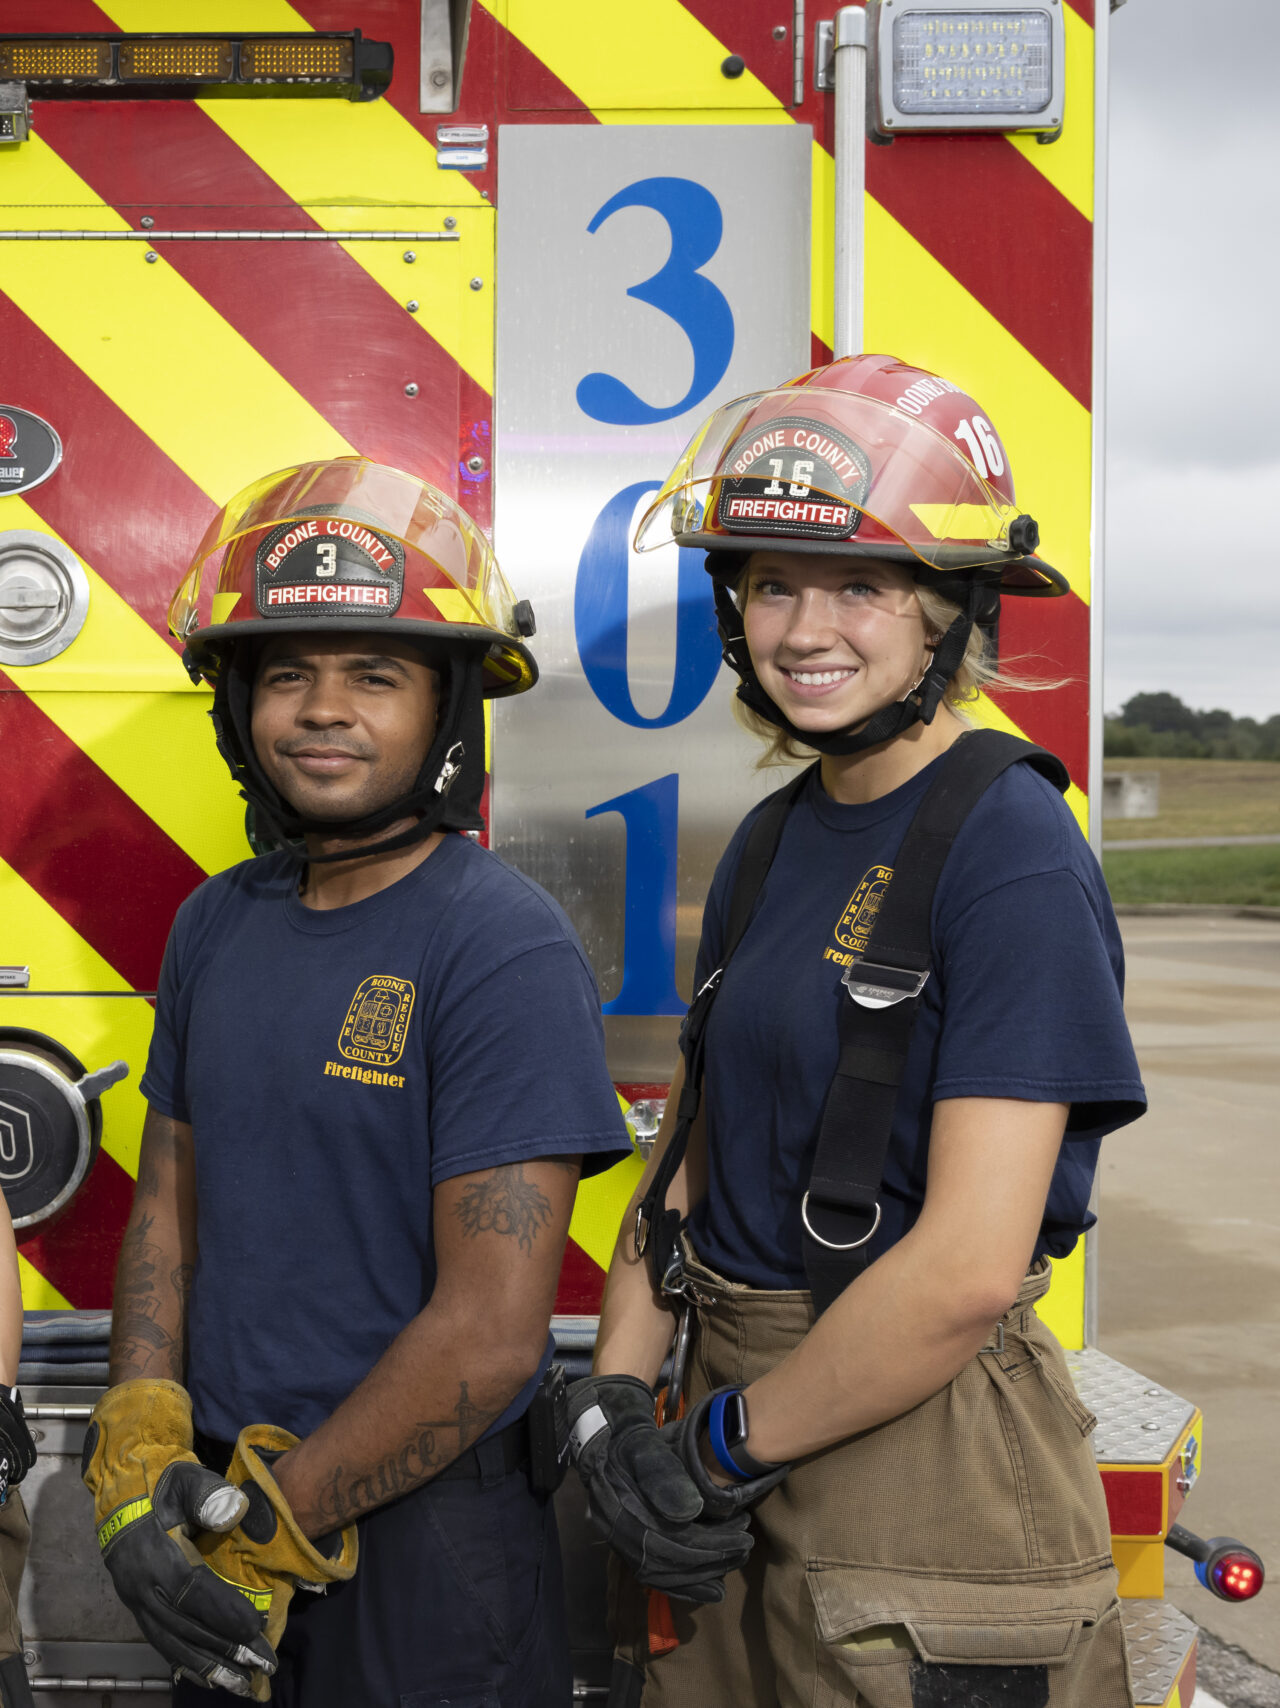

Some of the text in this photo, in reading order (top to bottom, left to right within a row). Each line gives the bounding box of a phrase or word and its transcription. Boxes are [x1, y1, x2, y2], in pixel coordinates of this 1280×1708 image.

[734, 430, 862, 482] BOONE COUNTY
[954, 415, 1005, 479] 16
[763, 458, 815, 498] 16
[729, 500, 849, 525] FIREFIGHTER
[266, 520, 394, 569] BOONE COUNTY
[315, 543, 338, 577] 3
[268, 585, 389, 605] FIREFIGHTER
[370, 978, 407, 993] BOONE
[343, 991, 365, 1037] FIRE
[391, 992, 412, 1053] RESCUE
[344, 1045, 393, 1064] COUNTY
[323, 1060, 407, 1089] Firefighter
